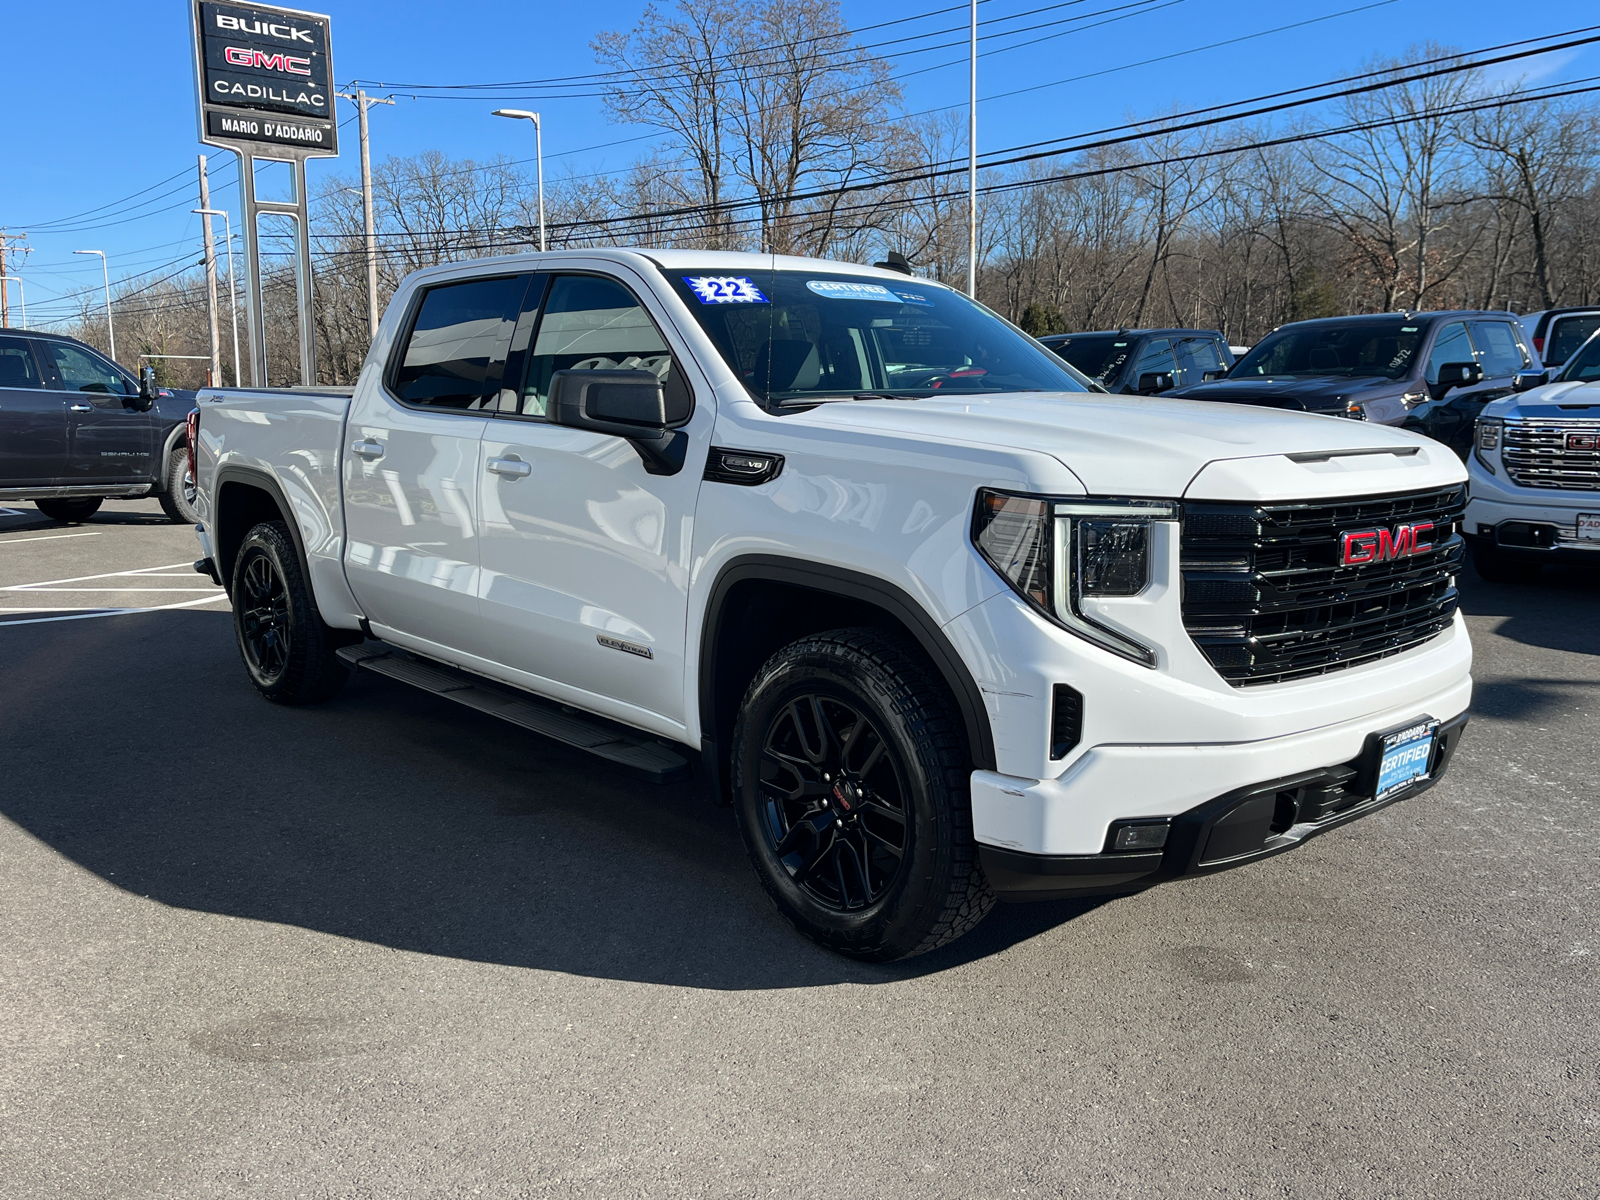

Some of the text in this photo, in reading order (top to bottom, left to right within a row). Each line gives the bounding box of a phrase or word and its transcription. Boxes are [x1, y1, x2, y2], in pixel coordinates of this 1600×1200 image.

[216, 14, 314, 43] BUICK
[224, 46, 311, 76] GMC
[214, 80, 325, 107] CADILLAC
[221, 118, 323, 143] MARIO D'ADDARIO
[707, 281, 747, 297] 22
[810, 282, 888, 295] CERTIFIED
[1569, 435, 1600, 449] G
[1341, 521, 1434, 566] GMC
[1380, 743, 1431, 776] CERTIFIED
